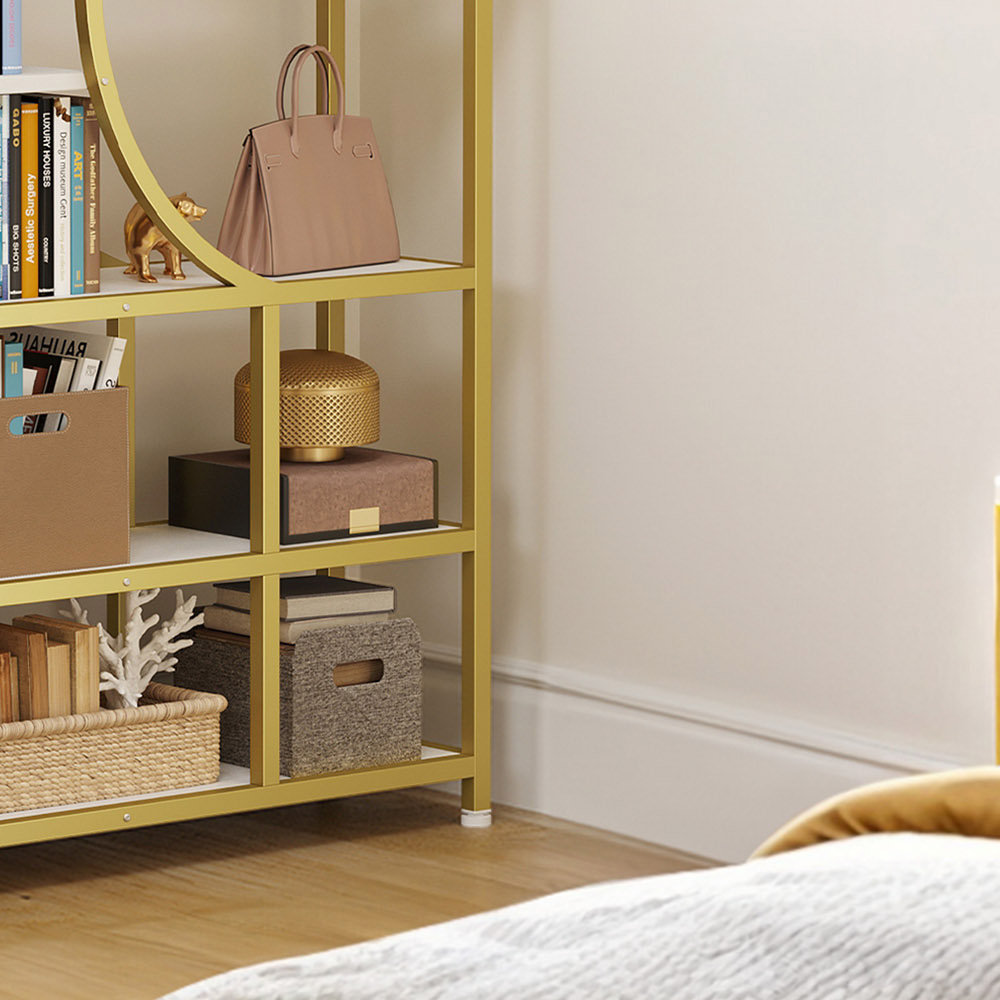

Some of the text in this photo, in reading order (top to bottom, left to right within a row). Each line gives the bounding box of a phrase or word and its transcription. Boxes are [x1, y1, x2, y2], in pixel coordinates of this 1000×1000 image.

[43, 112, 51, 148] LUXURY
[58, 132, 67, 159] Design
[43, 150, 51, 188] HOUSES
[74, 151, 82, 180] ART
[25, 174, 36, 264] Aestetic Surgery
